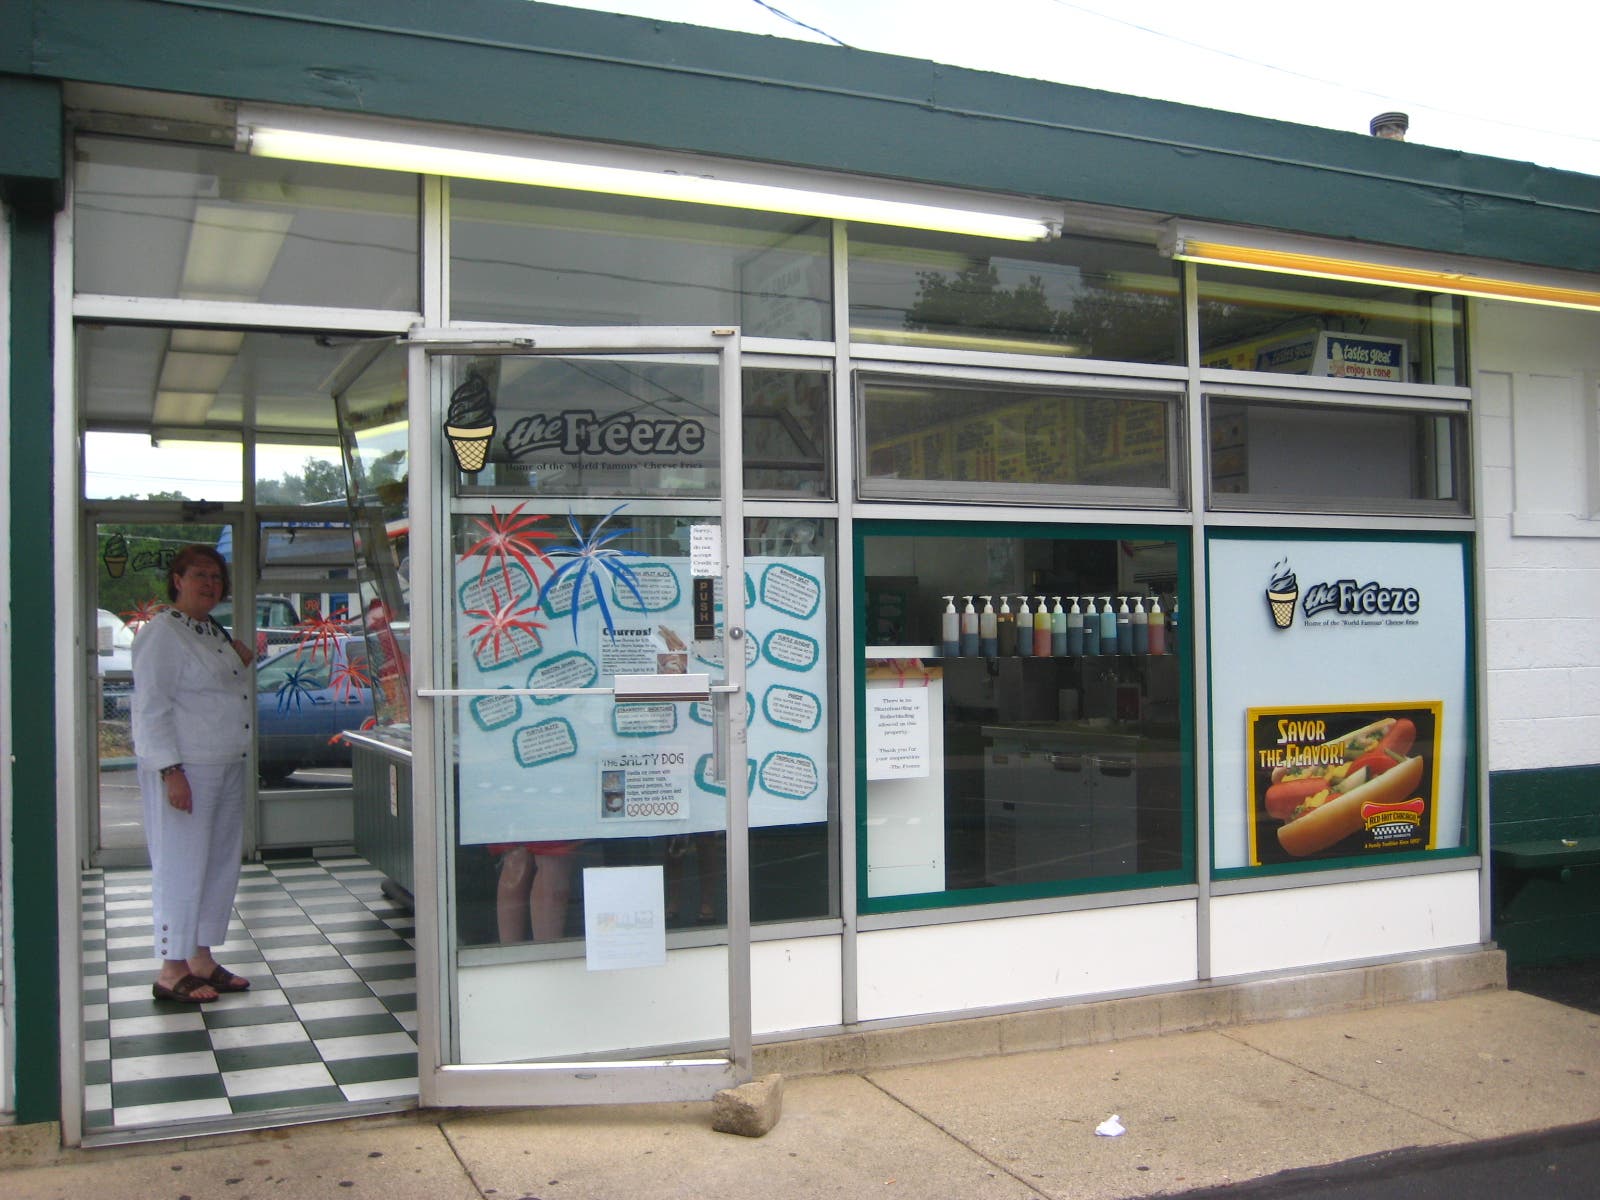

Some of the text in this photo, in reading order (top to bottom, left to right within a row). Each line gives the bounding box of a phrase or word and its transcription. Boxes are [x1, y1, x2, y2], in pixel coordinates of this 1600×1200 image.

[1343, 345, 1391, 366] tastes great
[1345, 366, 1391, 379] enjoy a cone
[504, 410, 704, 458] the Freeze
[537, 463, 548, 472] of
[549, 463, 565, 472] the
[700, 581, 709, 621] PUSH
[1303, 579, 1420, 618] the Freeze
[603, 627, 652, 636] Curros!
[1277, 719, 1326, 744] SAVOR
[619, 753, 659, 767] SALTY
[661, 752, 684, 765] DOG
[1259, 742, 1345, 768] THE FLAVOR!
[1370, 816, 1380, 824] RED
[1382, 814, 1392, 822] HOT
